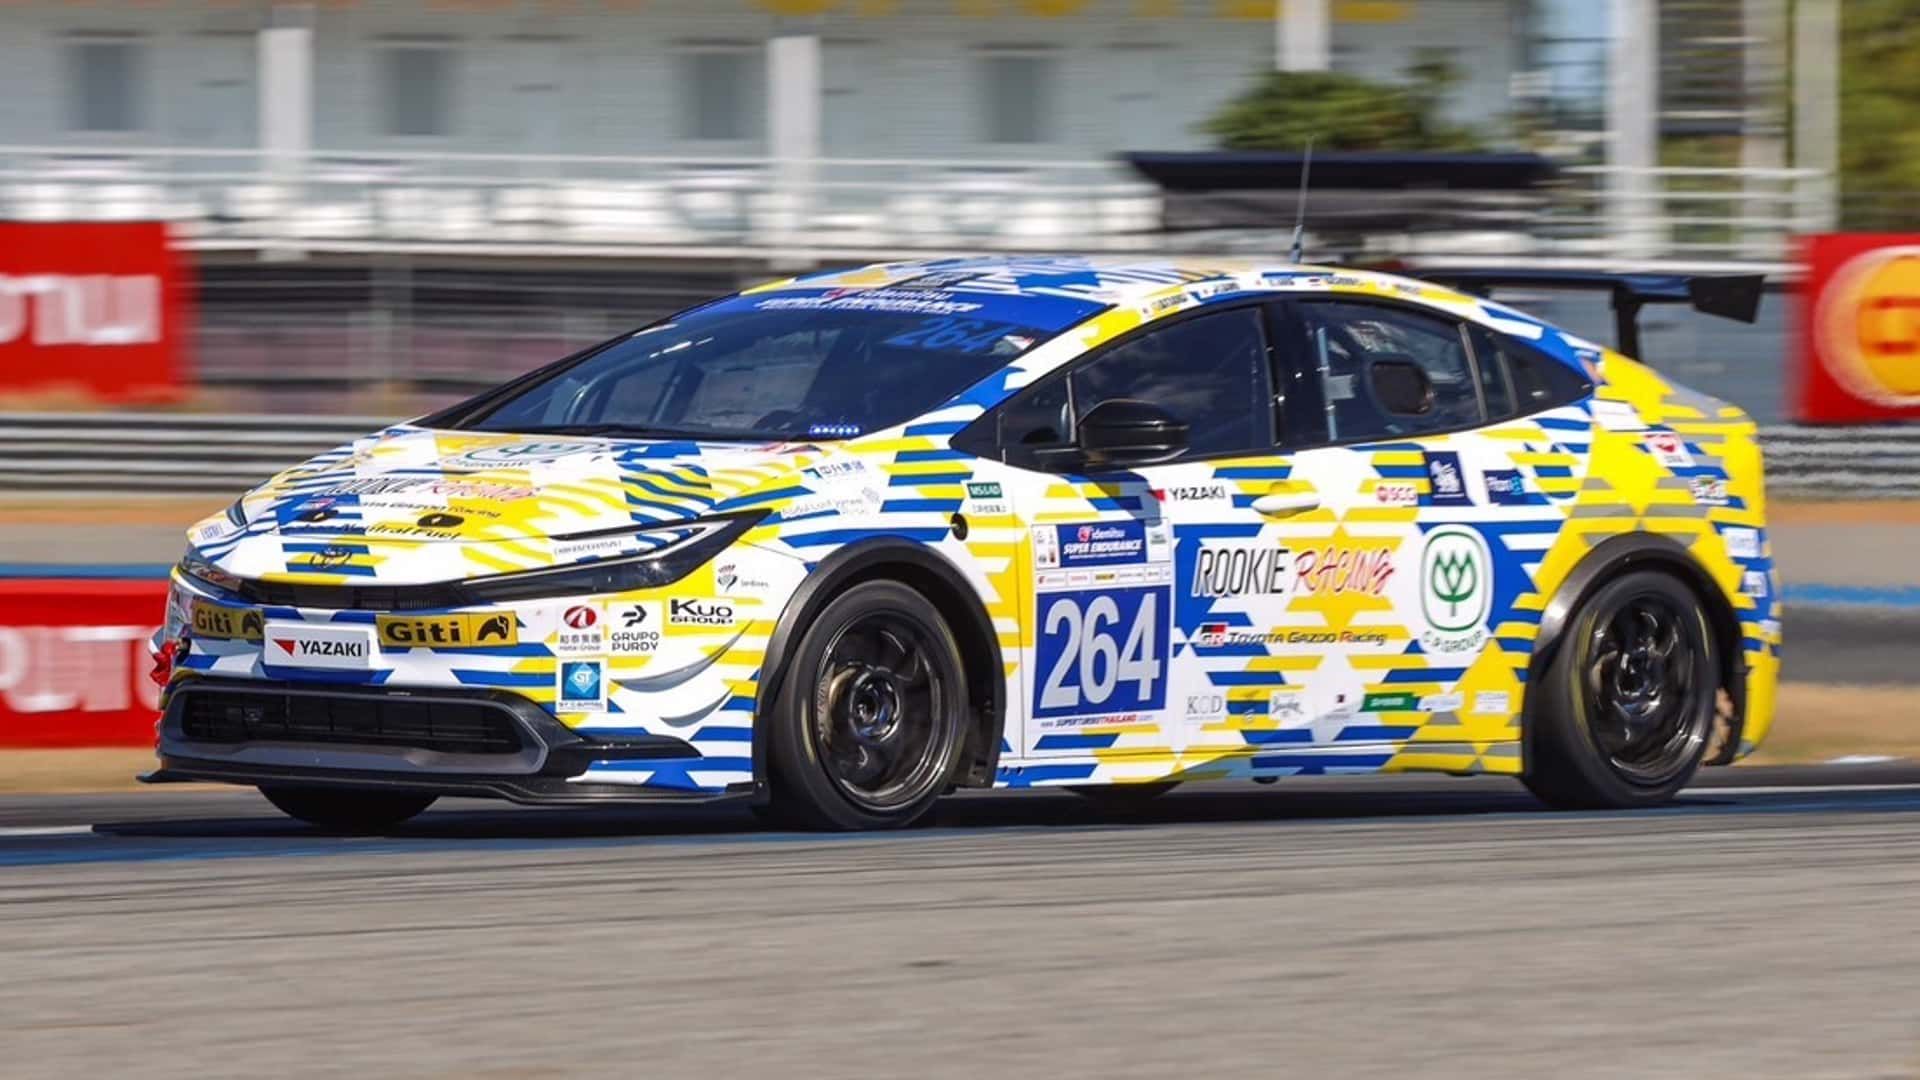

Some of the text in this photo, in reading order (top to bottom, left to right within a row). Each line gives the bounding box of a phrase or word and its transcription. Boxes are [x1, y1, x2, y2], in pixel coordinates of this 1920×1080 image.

[1168, 486, 1225, 501] YAZAKI
[1193, 547, 1395, 596] ROOKIE RACING
[196, 608, 232, 634] Giti
[386, 621, 461, 645] Giti
[611, 632, 660, 642] GRUPO
[1228, 632, 1284, 645] TOYOTA
[299, 640, 363, 657] YAZAKI
[611, 641, 659, 651] PURDY
[1039, 592, 1161, 710] 264
